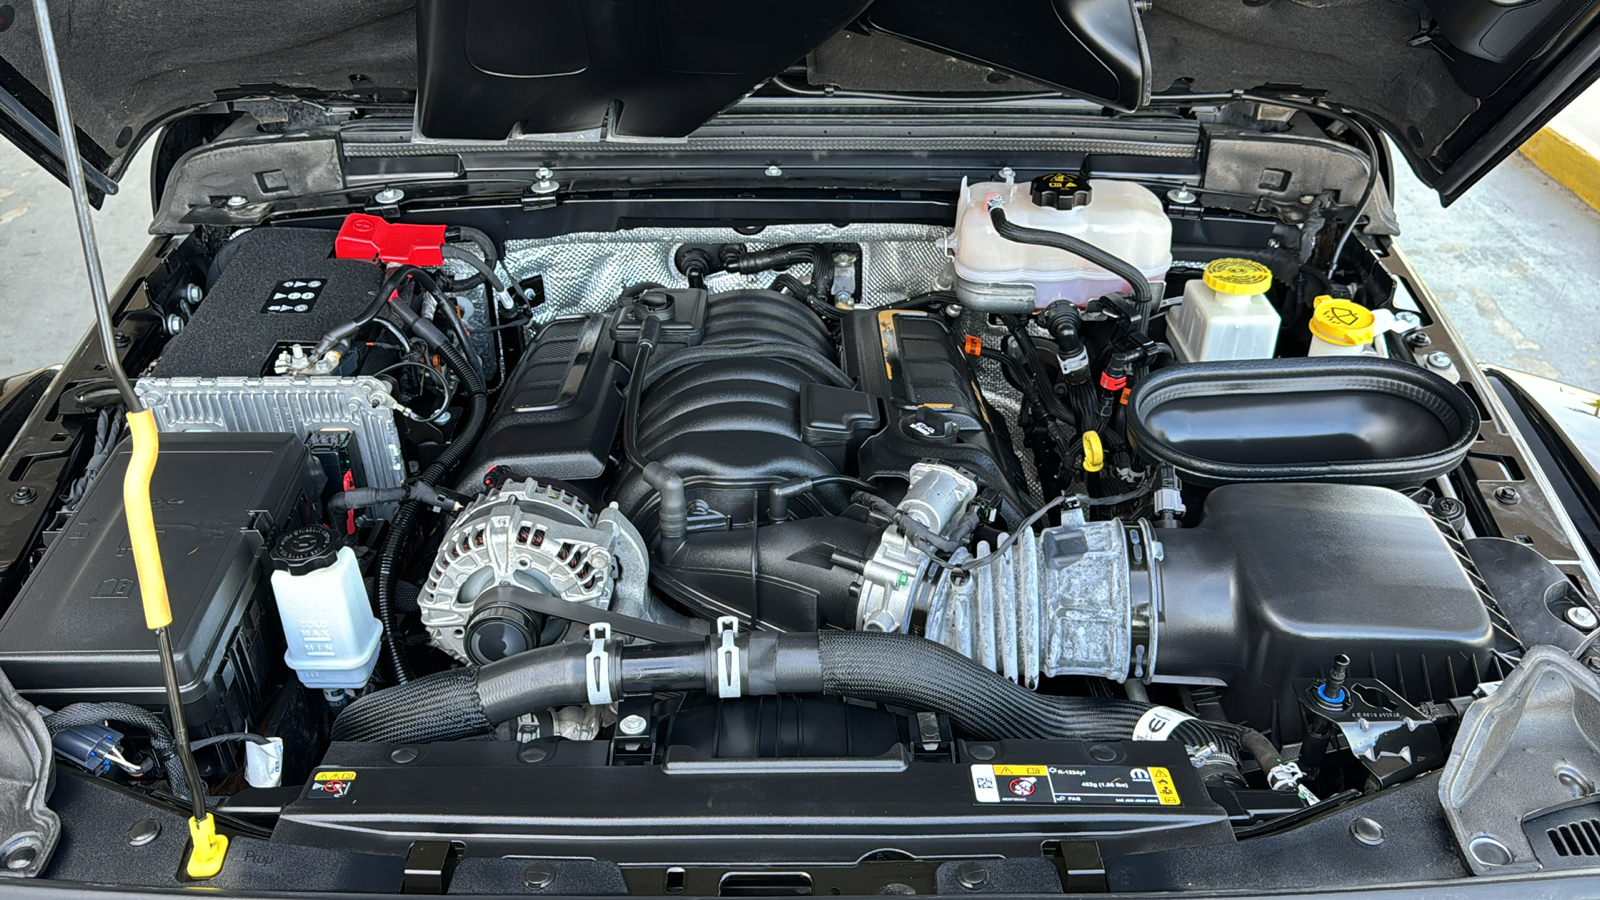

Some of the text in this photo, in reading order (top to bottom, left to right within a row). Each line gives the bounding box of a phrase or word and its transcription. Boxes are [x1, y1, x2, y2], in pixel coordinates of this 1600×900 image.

[300, 629, 330, 637] MAX
[304, 644, 333, 652] MIN
[243, 850, 274, 867] Prop
